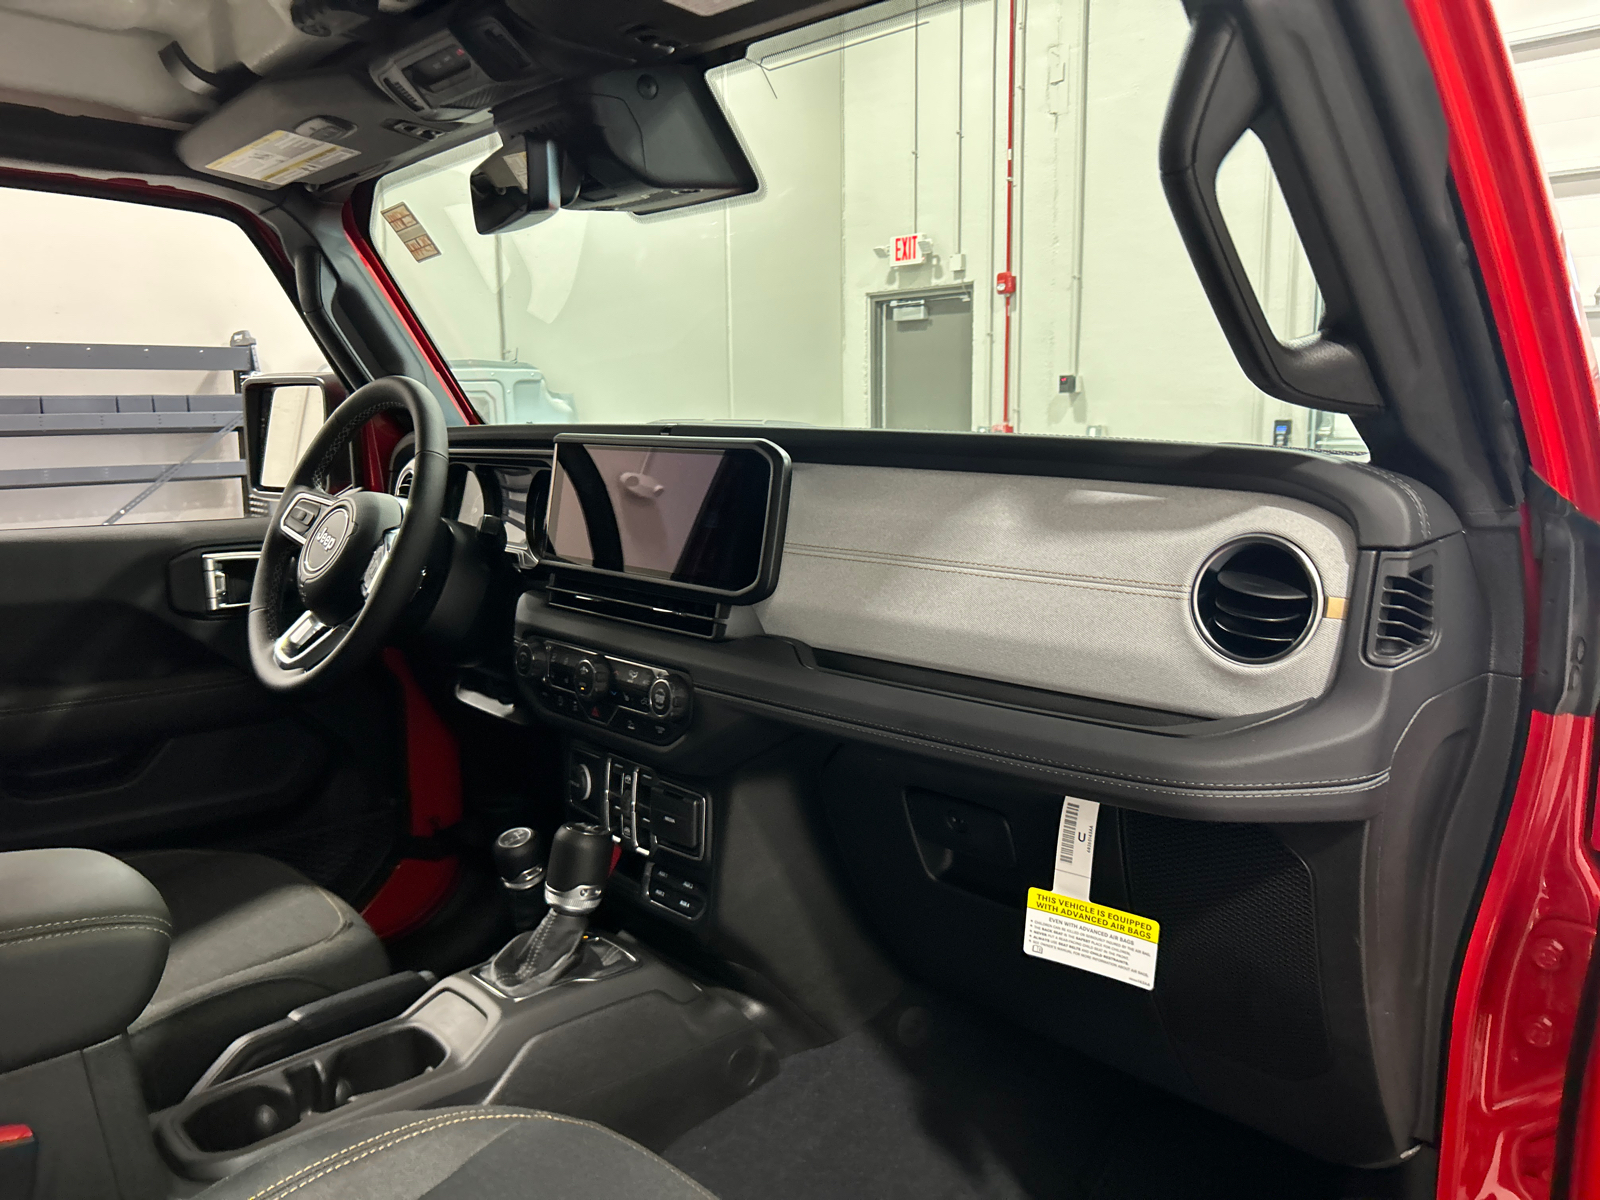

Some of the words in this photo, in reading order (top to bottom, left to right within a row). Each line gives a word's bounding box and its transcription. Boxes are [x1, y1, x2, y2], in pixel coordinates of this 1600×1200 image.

[894, 235, 918, 262] EXIT
[316, 527, 336, 552] Jeep
[1036, 893, 1056, 904] THIS
[1058, 898, 1094, 914] VEHICLE
[1096, 909, 1105, 917] IS
[1107, 912, 1152, 931] EQUIPPED
[1036, 900, 1058, 912] WITH
[1060, 907, 1108, 926] ADVANCED
[1110, 921, 1125, 931] AIR
[1127, 926, 1151, 939] BAGS
[1048, 916, 1062, 925] EVEN
[1063, 921, 1077, 929] WITH
[1079, 925, 1108, 937] ADVANCED
[1119, 937, 1134, 945] BAGS
